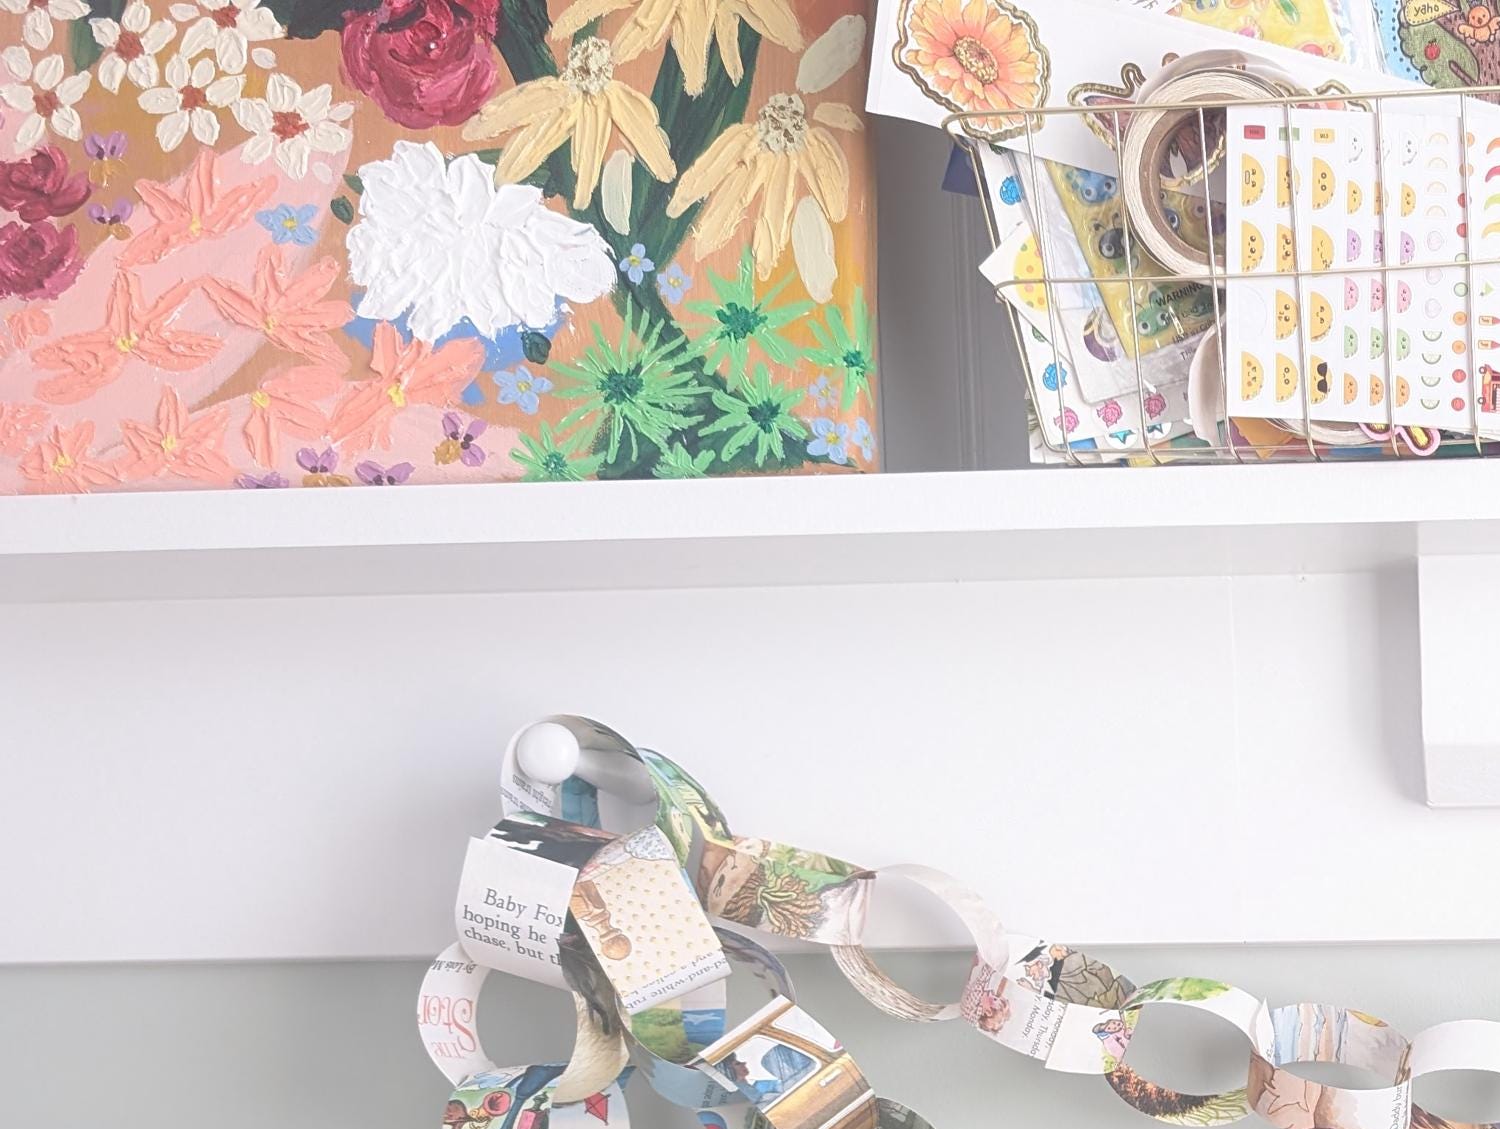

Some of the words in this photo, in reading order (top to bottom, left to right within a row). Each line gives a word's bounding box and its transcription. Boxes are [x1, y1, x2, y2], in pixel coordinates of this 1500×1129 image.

[1414, 3, 1439, 17] yaho
[483, 888, 527, 919] Baby
[463, 905, 521, 940] hoping
[528, 925, 547, 945] he
[516, 941, 545, 961] but
